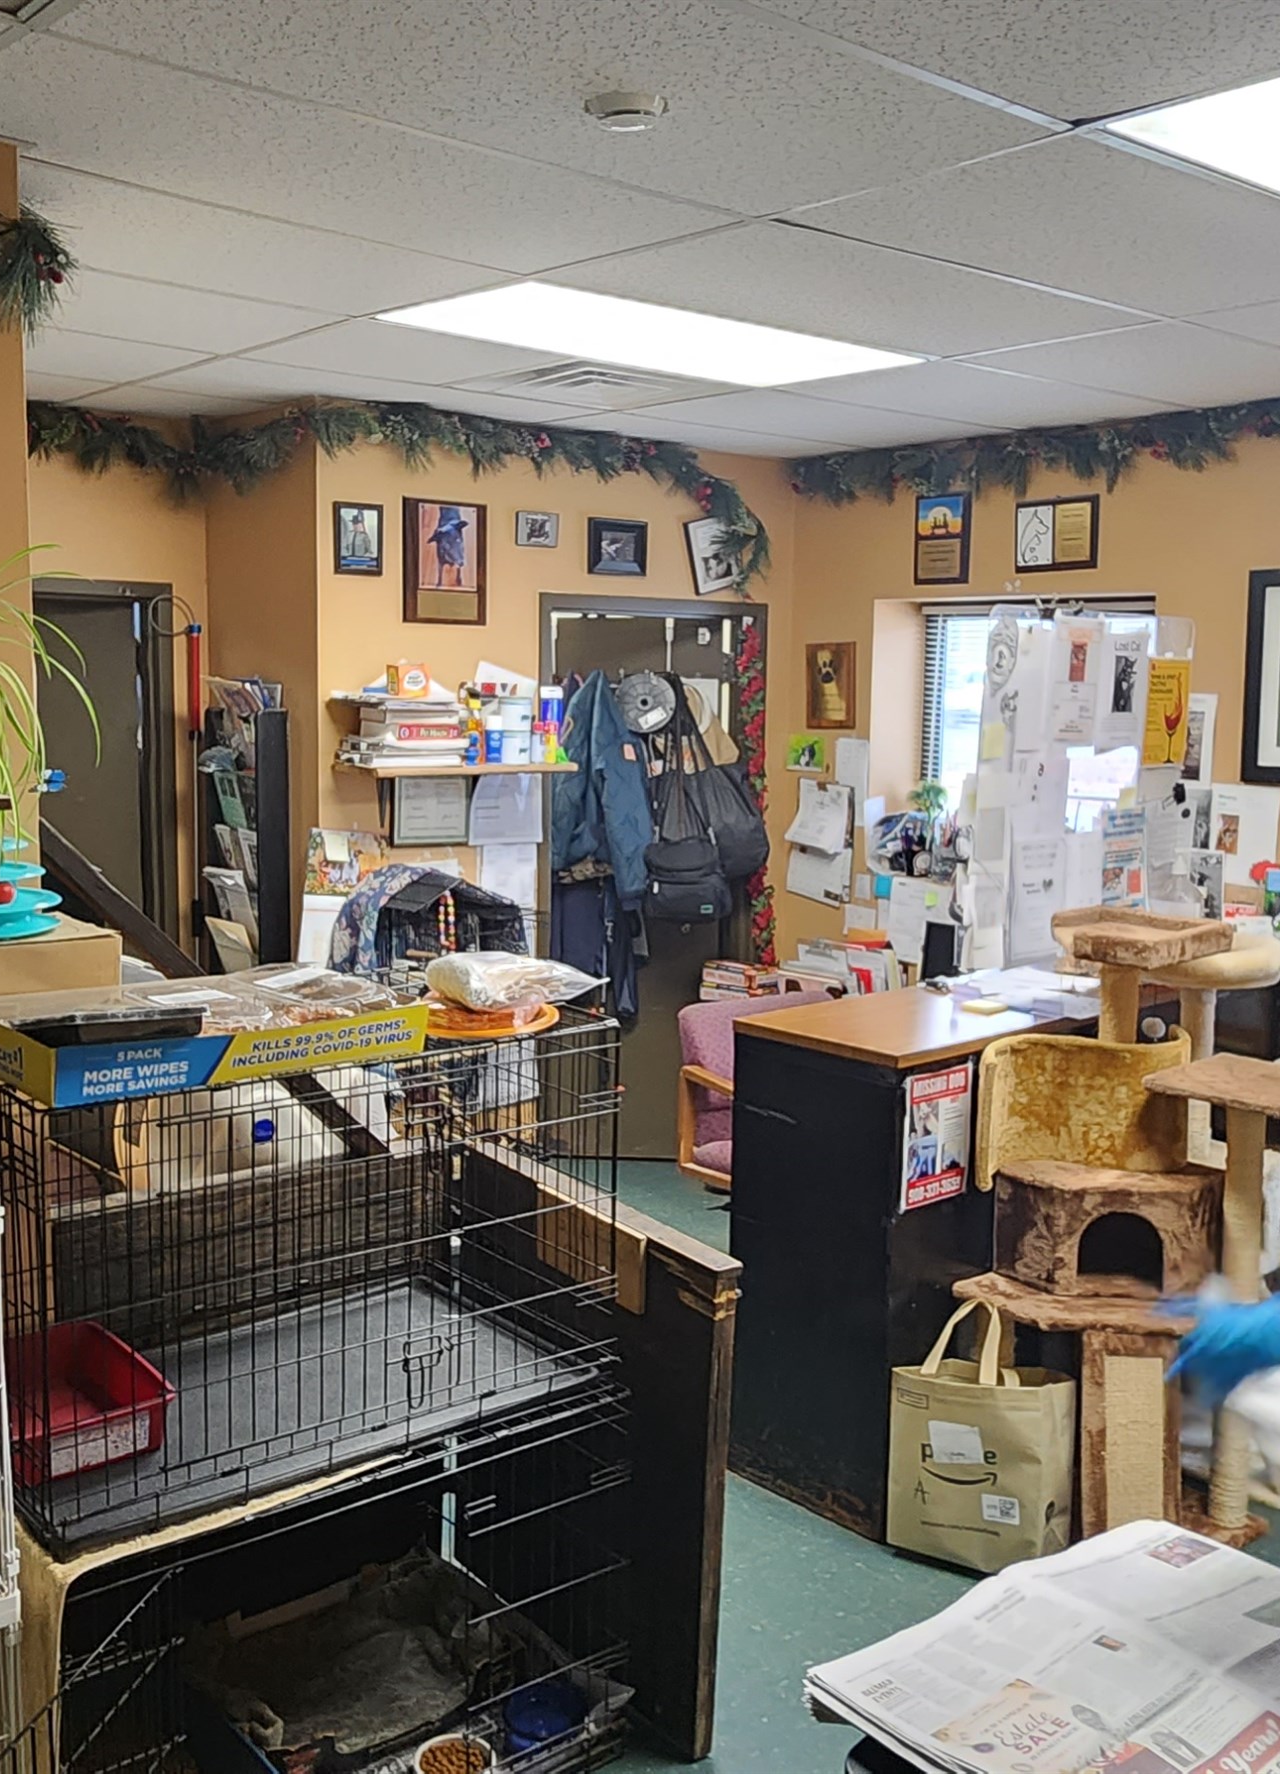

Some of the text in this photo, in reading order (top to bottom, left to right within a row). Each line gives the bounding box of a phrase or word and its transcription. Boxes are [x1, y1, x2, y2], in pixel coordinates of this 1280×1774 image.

[251, 1036, 291, 1053] KILLS
[295, 1030, 335, 1047] 99.9%
[338, 1027, 356, 1040] OF
[127, 1048, 163, 1061] PACK
[231, 1049, 310, 1069] INCLUDING
[313, 1038, 372, 1056] COVID-19
[83, 1060, 189, 1084] MORE WIPES
[82, 1073, 188, 1098] MORE SAVINGS
[993, 1711, 1051, 1748] Estate
[1014, 1716, 1072, 1755] SALE
